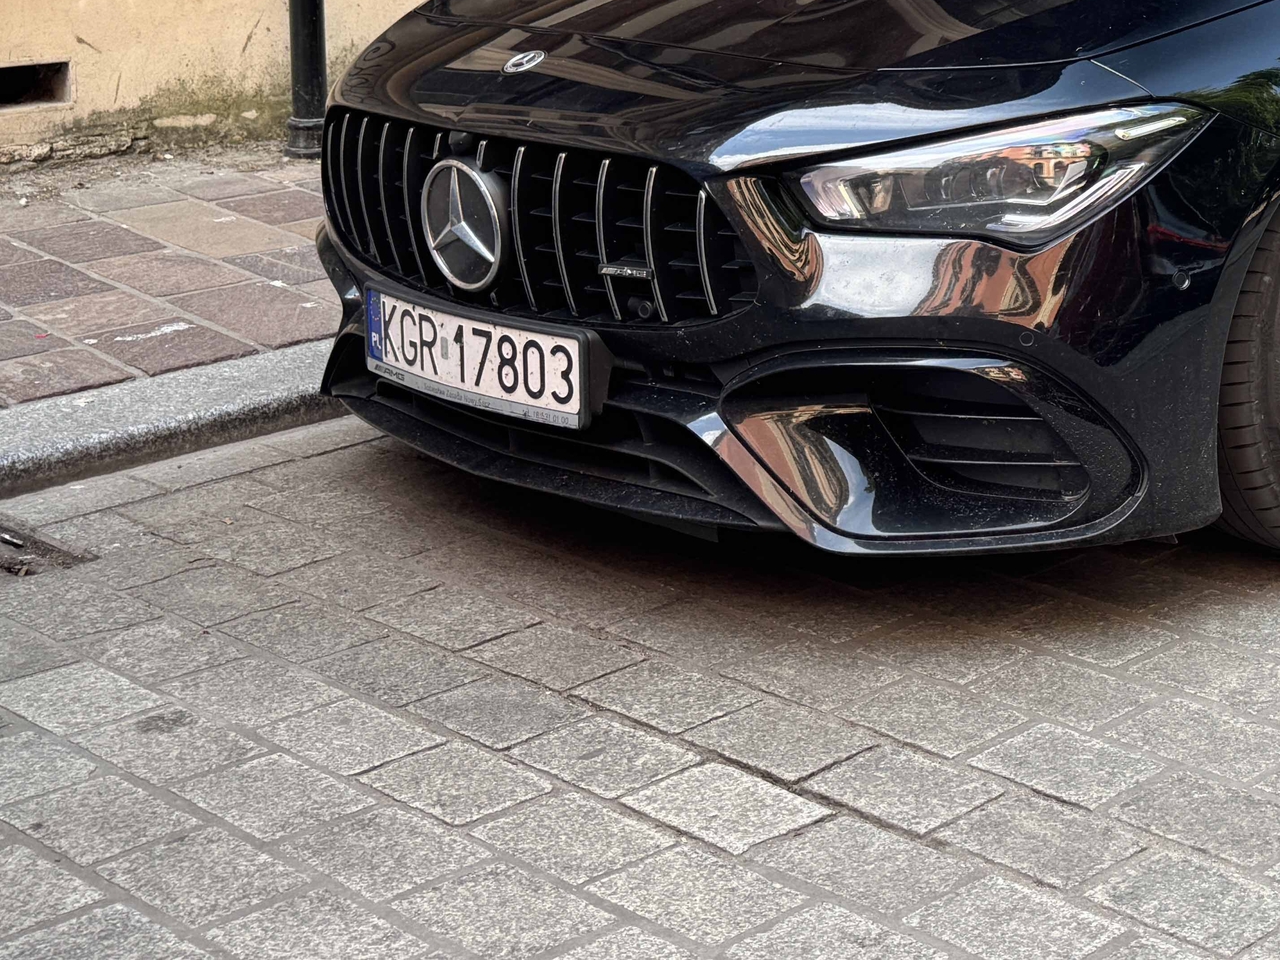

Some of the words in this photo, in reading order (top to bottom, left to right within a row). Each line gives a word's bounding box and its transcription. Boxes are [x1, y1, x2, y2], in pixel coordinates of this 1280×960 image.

[371, 332, 382, 350] PL
[382, 300, 439, 376] KGR
[453, 324, 574, 405] 17803
[382, 365, 406, 382] AMG
